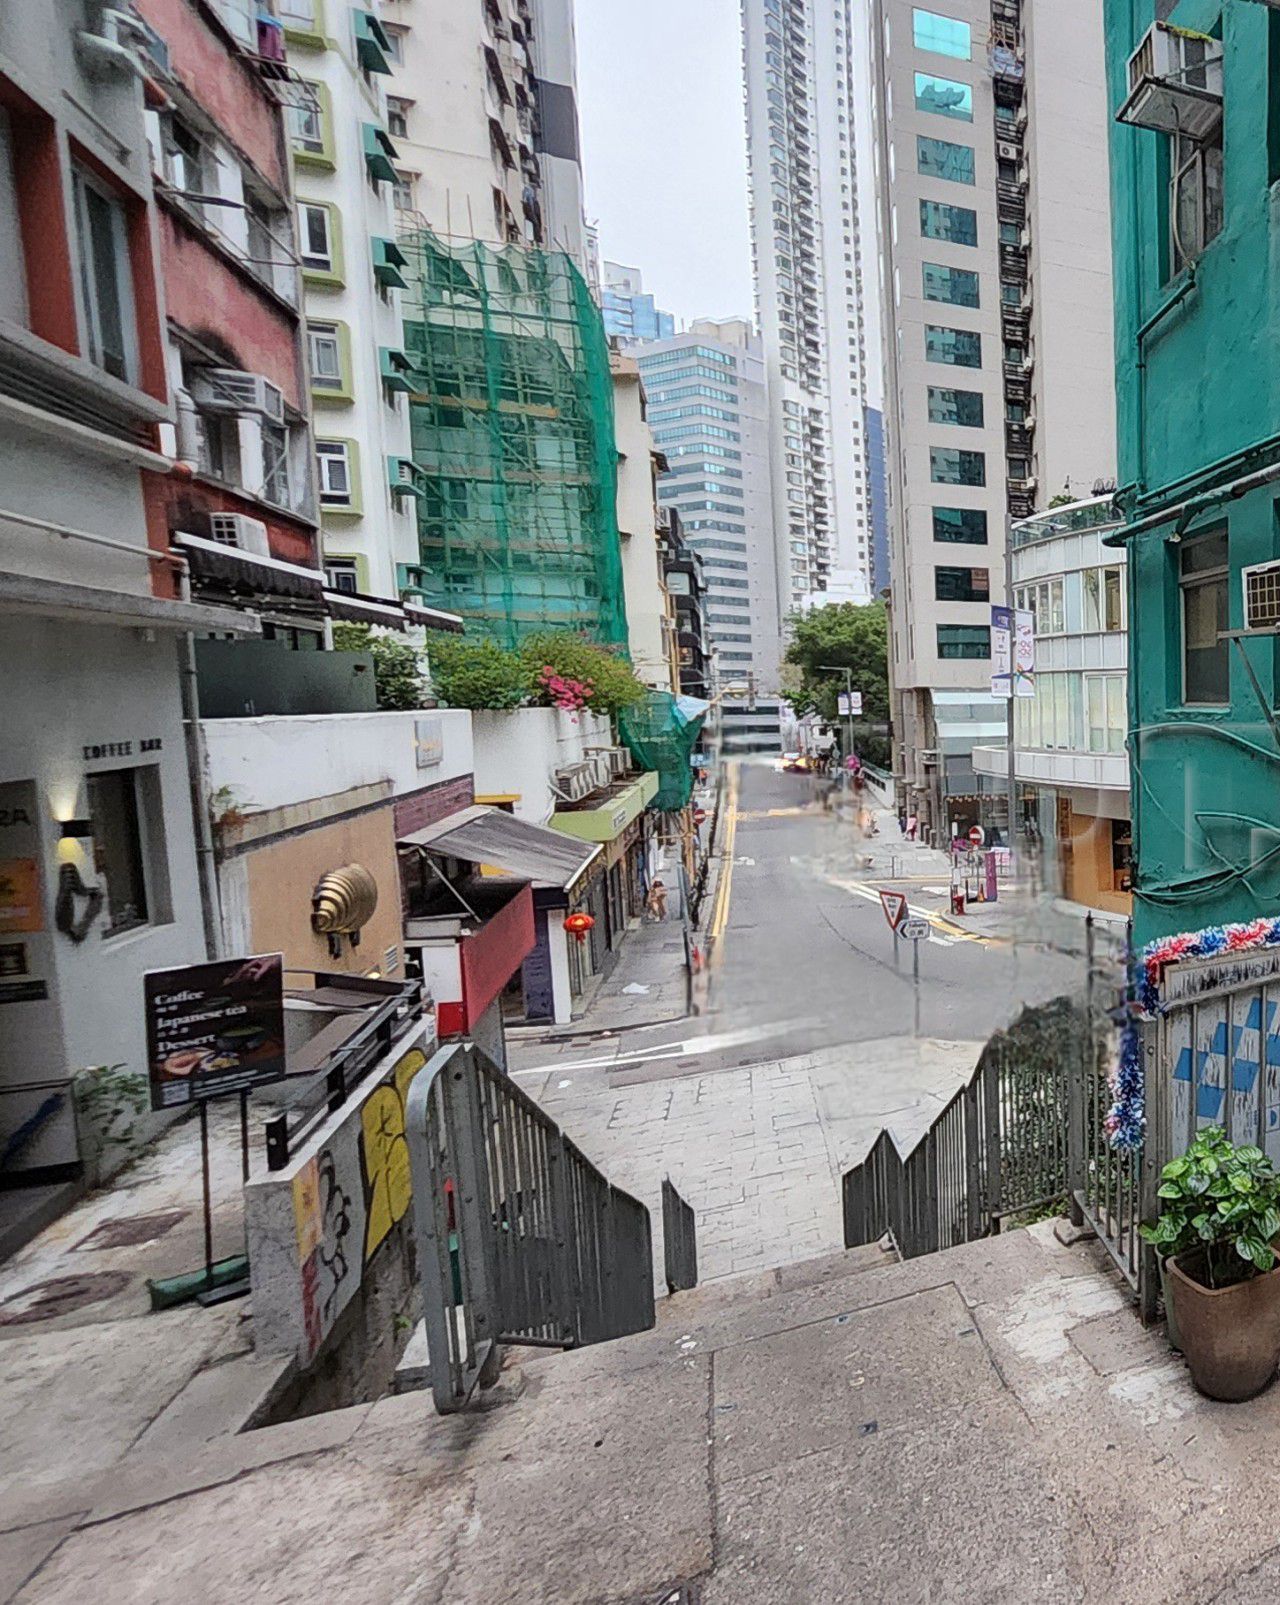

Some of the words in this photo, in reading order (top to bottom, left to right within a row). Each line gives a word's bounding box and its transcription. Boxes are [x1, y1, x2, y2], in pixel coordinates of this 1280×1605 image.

[83, 740, 132, 760] COFFEE
[154, 990, 205, 1005] Coffee
[157, 1009, 224, 1029] Japanese
[225, 1005, 248, 1016] tea
[158, 1034, 216, 1052] Dessert
